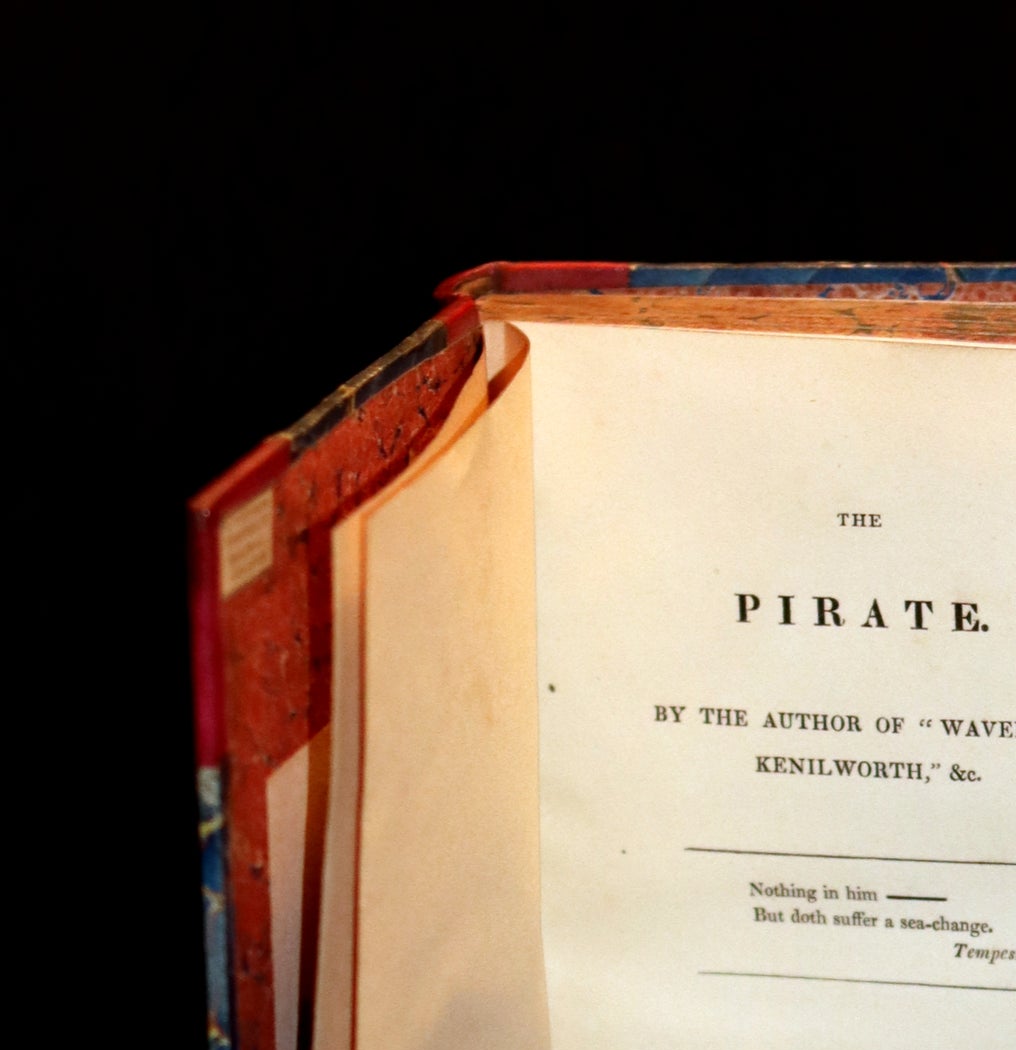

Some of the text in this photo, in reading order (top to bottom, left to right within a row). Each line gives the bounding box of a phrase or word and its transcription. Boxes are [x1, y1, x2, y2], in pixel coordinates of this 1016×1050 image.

[836, 512, 883, 528] THE
[733, 592, 990, 633] PIRATE.
[653, 704, 687, 724] BY
[698, 706, 749, 728] THE
[762, 711, 863, 733] AUTHOR
[875, 716, 905, 735] OF
[948, 763, 983, 783] &c.
[749, 881, 878, 904] Nothing in him
[753, 906, 994, 938] But doth suffer a sea-change.
